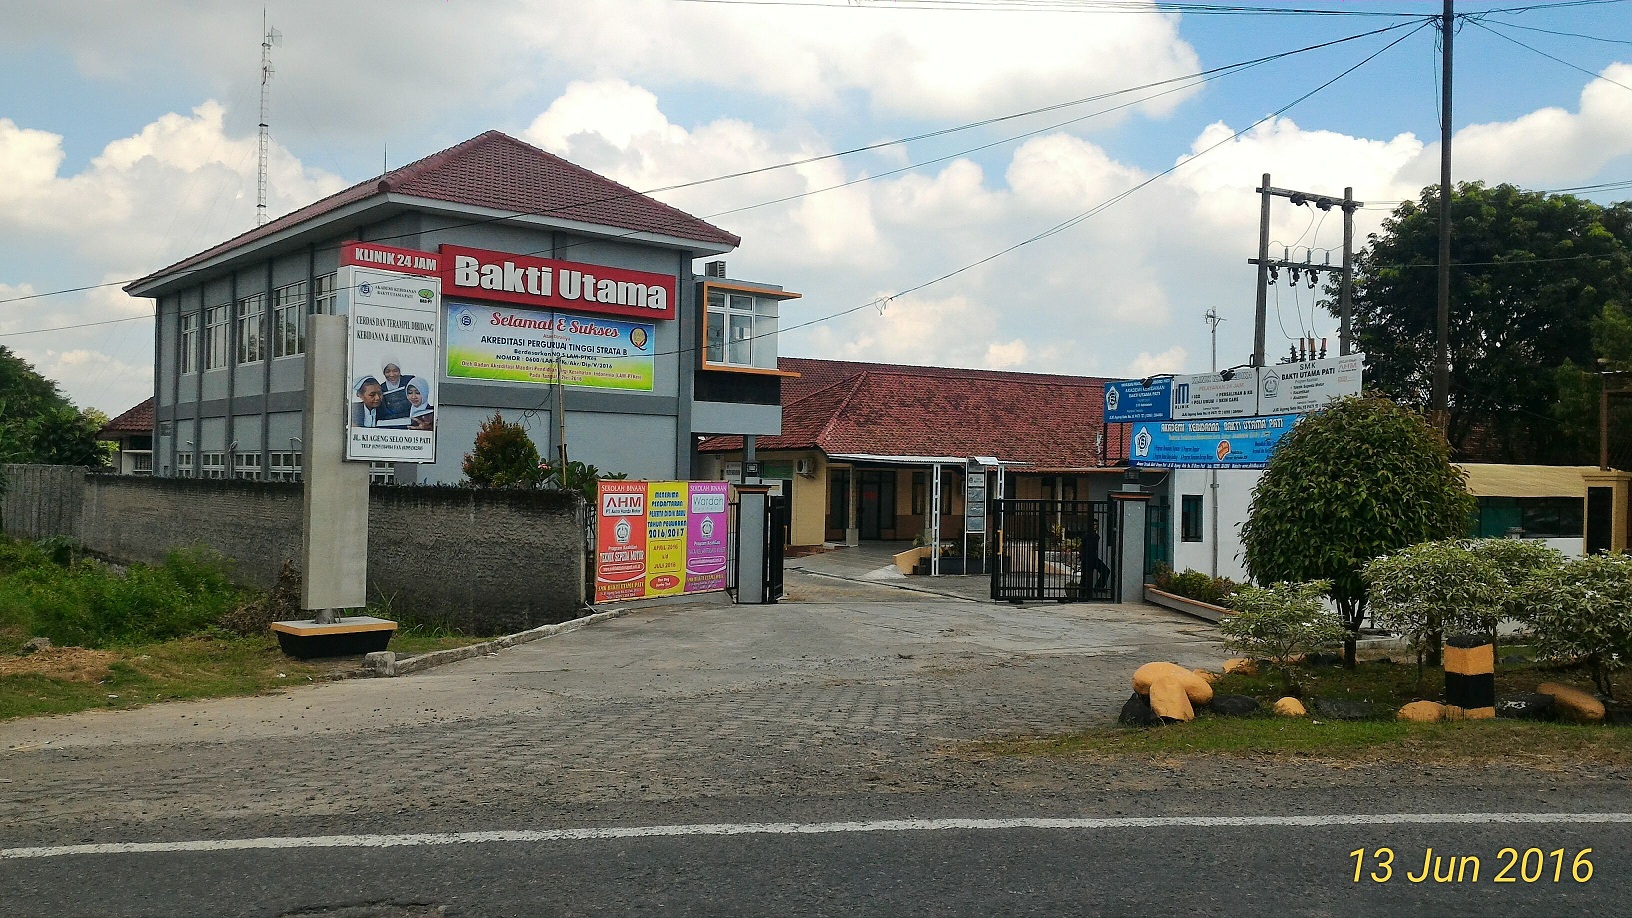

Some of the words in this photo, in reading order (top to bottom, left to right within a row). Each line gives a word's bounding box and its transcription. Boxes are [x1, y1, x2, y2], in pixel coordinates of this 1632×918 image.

[355, 247, 395, 266] KLINIK
[396, 253, 412, 268] 24
[413, 256, 437, 272] JAM
[454, 254, 553, 298] Bakti
[558, 268, 668, 311] Utama
[356, 315, 376, 326] CERDAS
[376, 317, 386, 328] DAN
[387, 318, 411, 330] TERAMPIL
[411, 321, 434, 333] DIBIDANG
[490, 311, 554, 331] Selamat
[569, 319, 620, 338] Sukses
[356, 329, 385, 342] KEBIDANAN
[385, 332, 390, 342] &
[391, 333, 402, 343] AHLI
[402, 334, 433, 346] KECANTIKAN
[480, 335, 525, 347] AKREDITASI
[568, 342, 595, 353] TINGGI
[596, 345, 622, 356] STRATA
[622, 348, 628, 356] B
[496, 354, 521, 362] NOMOR
[1299, 361, 1316, 371] SMK
[1281, 372, 1299, 381] BAKTI
[1299, 370, 1320, 379] UTAMA
[1321, 367, 1336, 375] PATI
[1268, 418, 1284, 428] PATI
[369, 435, 389, 443] AGENG
[389, 436, 403, 444] SELO
[404, 436, 413, 444] NO
[413, 436, 419, 444] 15
[601, 484, 625, 492] SEKOLAH
[606, 496, 641, 508] AHM
[648, 528, 685, 538] 2016/2017
